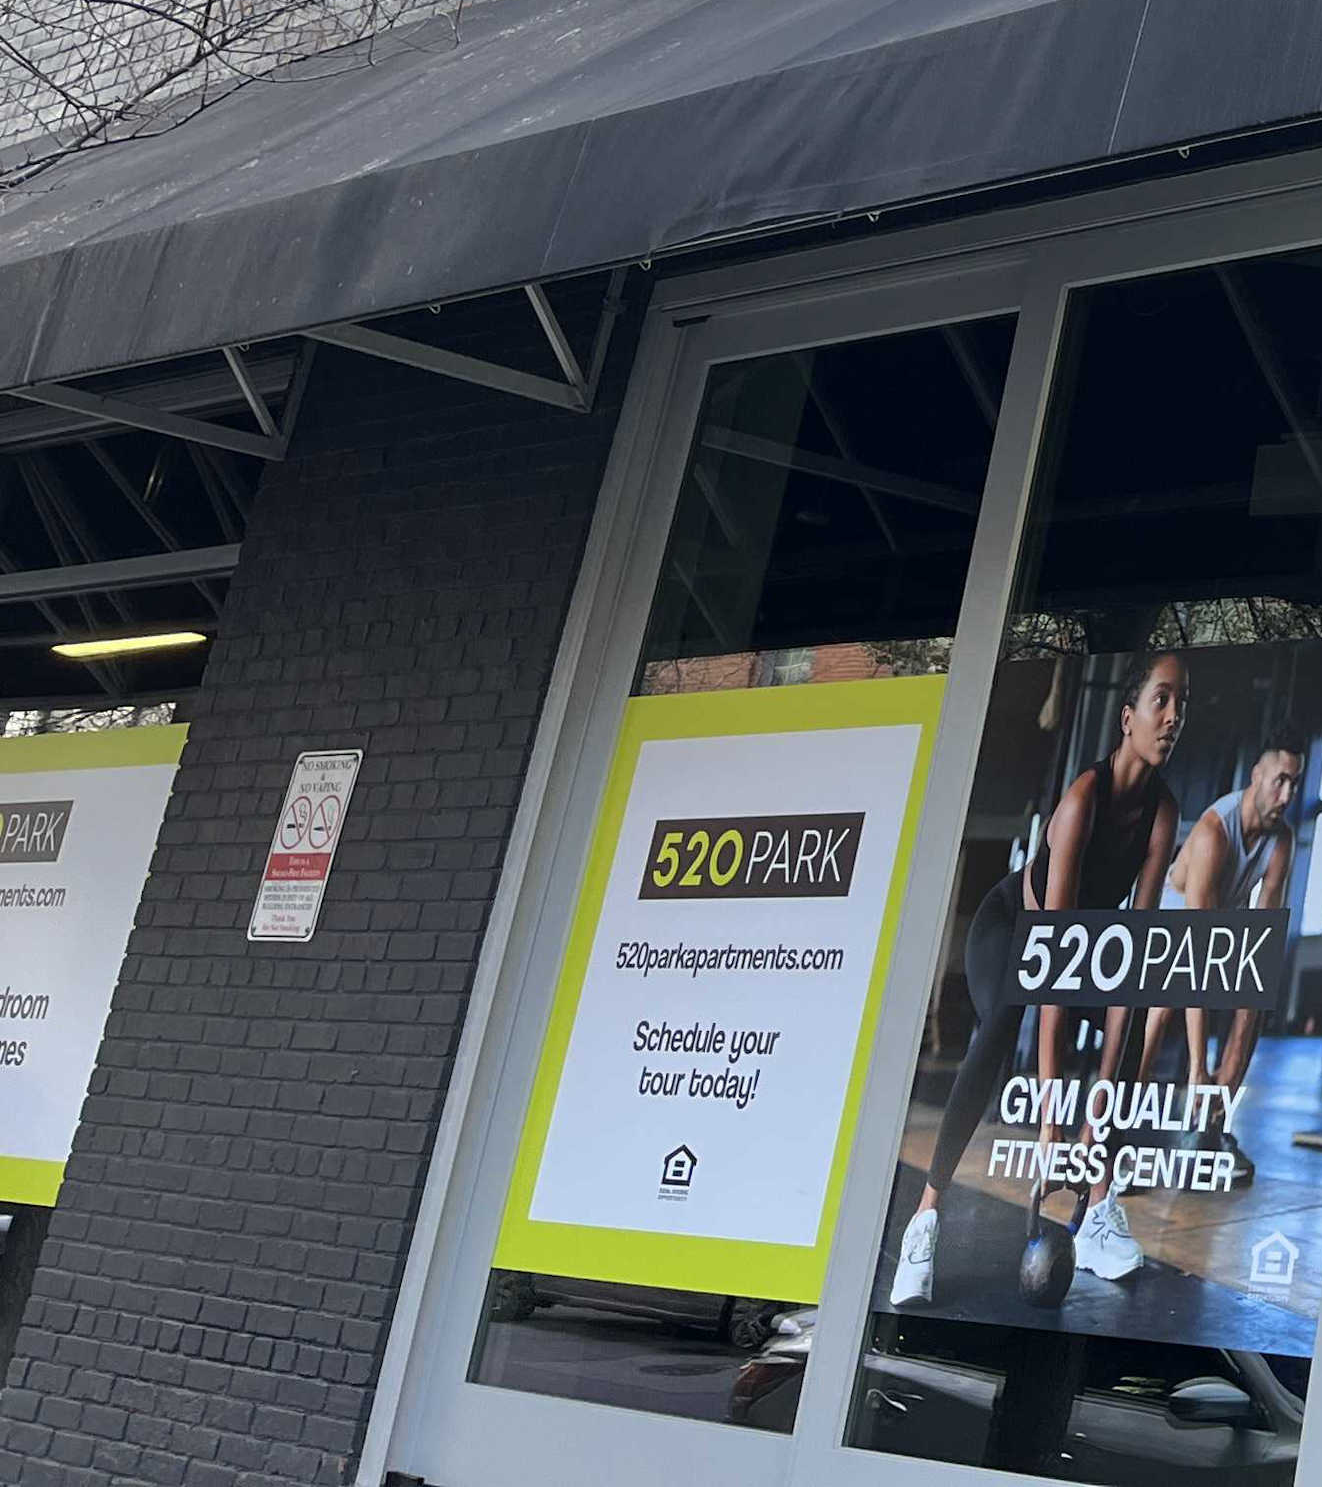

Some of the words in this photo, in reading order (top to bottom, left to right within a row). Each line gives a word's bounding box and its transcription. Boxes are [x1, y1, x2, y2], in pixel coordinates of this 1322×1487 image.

[1, 812, 64, 852] PARK
[652, 829, 744, 888] 520
[745, 828, 850, 884] PARK
[615, 941, 844, 978] 520parkapartments.com
[1018, 923, 1133, 991] 520
[1138, 926, 1272, 992] PARK
[633, 1020, 725, 1054] Schedule
[728, 1031, 781, 1064] your
[639, 1066, 686, 1096] tour
[689, 1067, 761, 1109] today!
[1000, 1076, 1081, 1126] GYM
[1085, 1079, 1248, 1142] QUALITY
[987, 1138, 1108, 1185] FITNESS
[1112, 1145, 1236, 1193] CENTER
